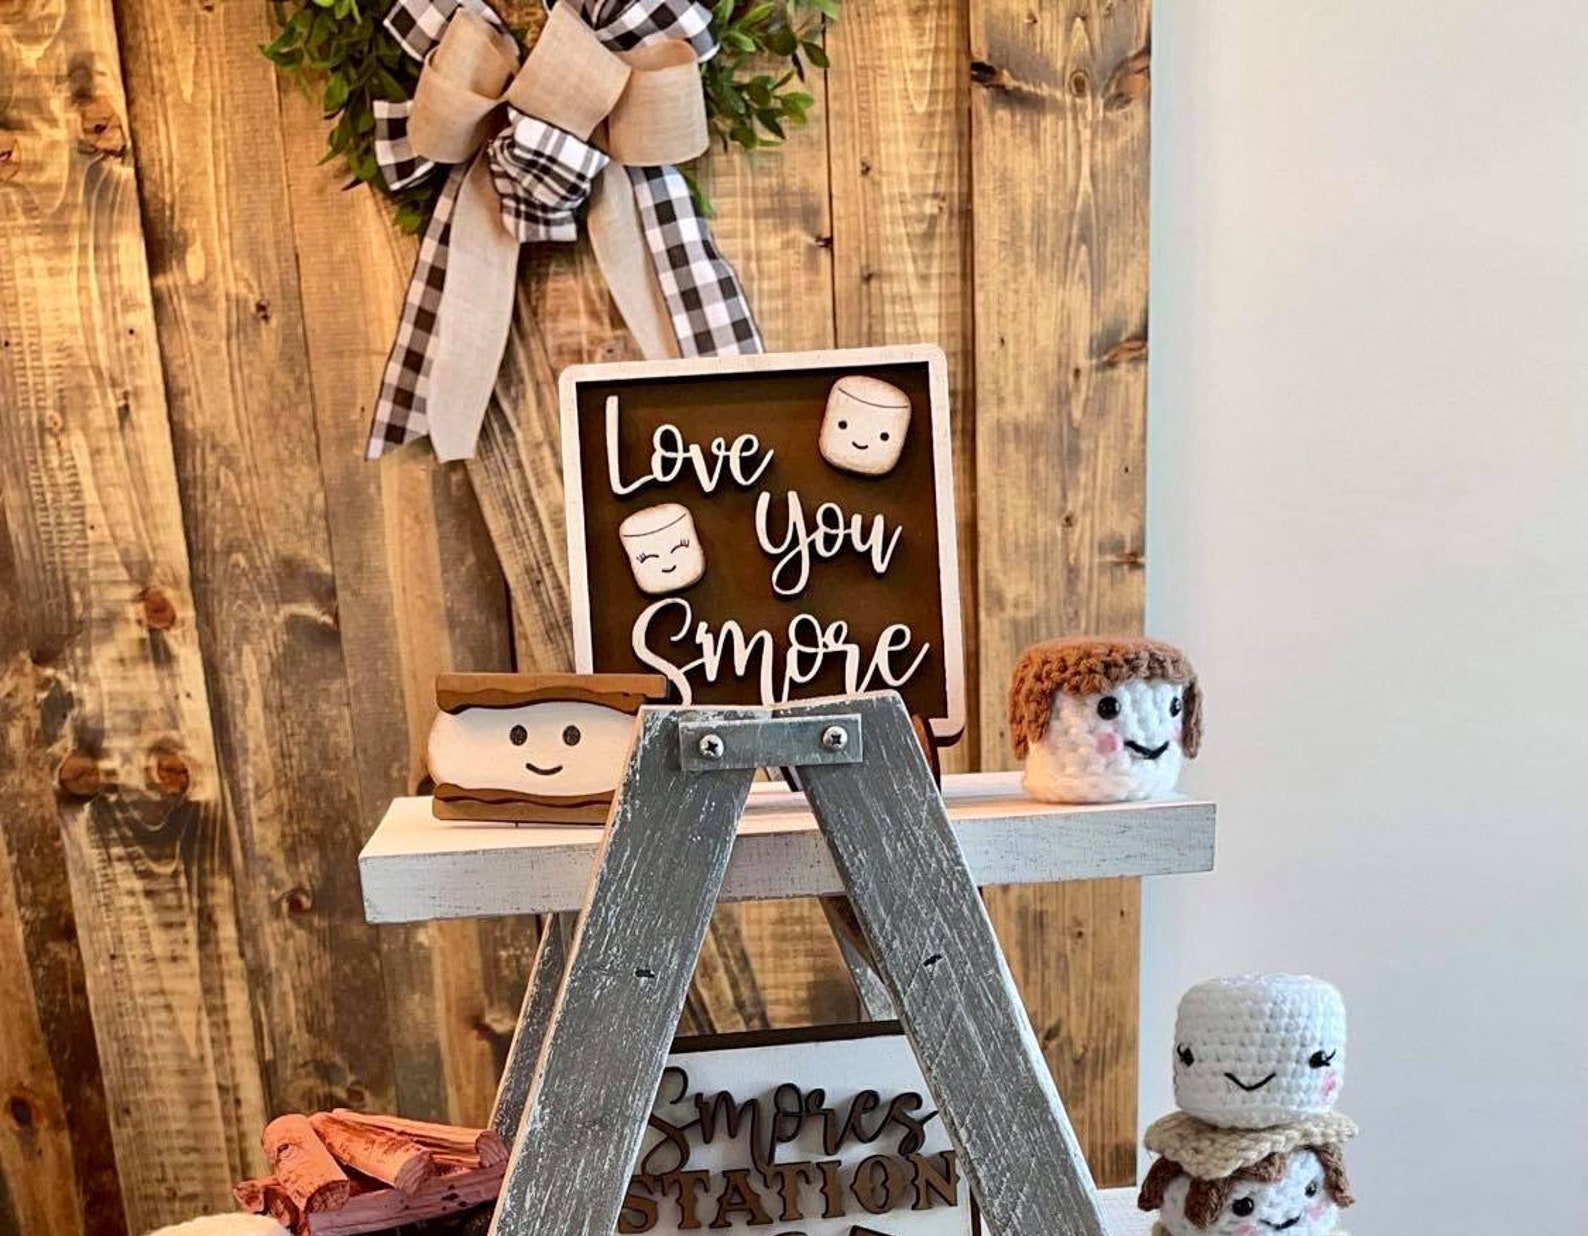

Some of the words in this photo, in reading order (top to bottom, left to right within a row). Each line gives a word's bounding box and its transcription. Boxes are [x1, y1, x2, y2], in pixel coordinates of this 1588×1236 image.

[605, 394, 774, 496] Love
[755, 490, 902, 596] You
[632, 597, 930, 706] Smore
[641, 1066, 938, 1178] Smores
[618, 1150, 961, 1235] STATION
